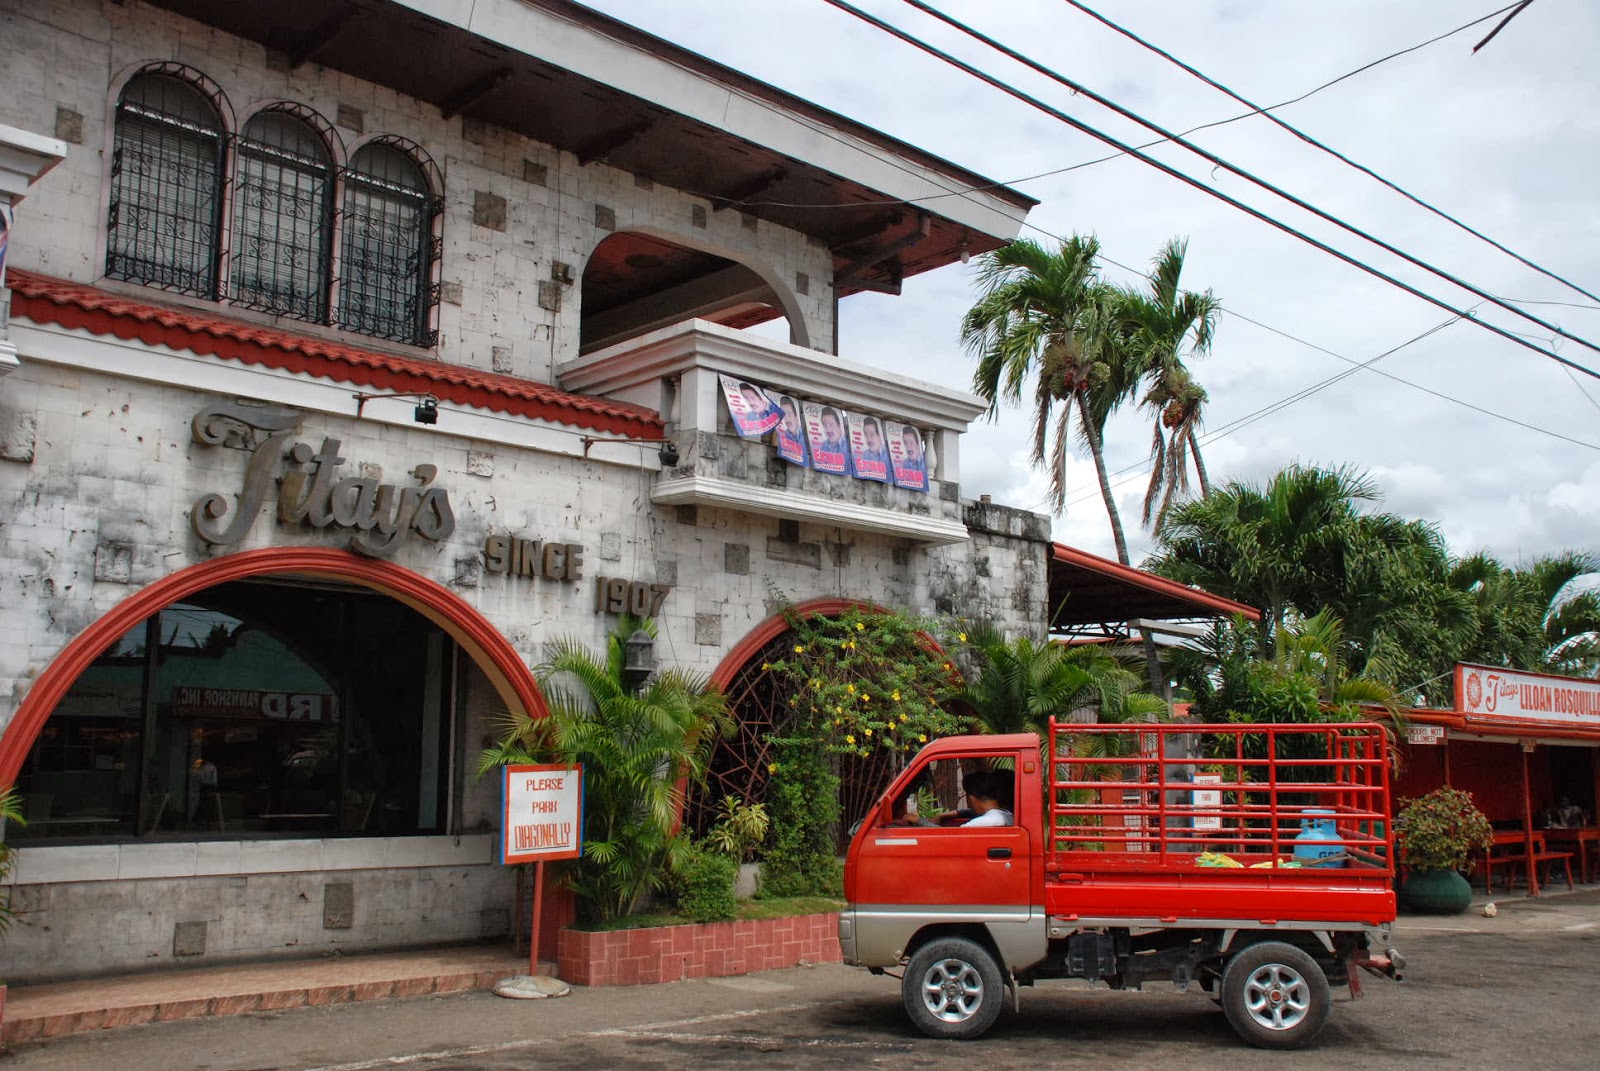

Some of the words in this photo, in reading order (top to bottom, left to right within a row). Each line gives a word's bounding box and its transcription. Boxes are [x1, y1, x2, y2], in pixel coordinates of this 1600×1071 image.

[191, 403, 456, 557] Titay's
[485, 535, 584, 582] SINCE
[596, 575, 671, 618] 1907
[1520, 684, 1552, 711] LILOAN
[526, 778, 563, 791] PLEASE
[532, 800, 558, 813] PARK
[514, 822, 571, 849] DIAGONALLY
